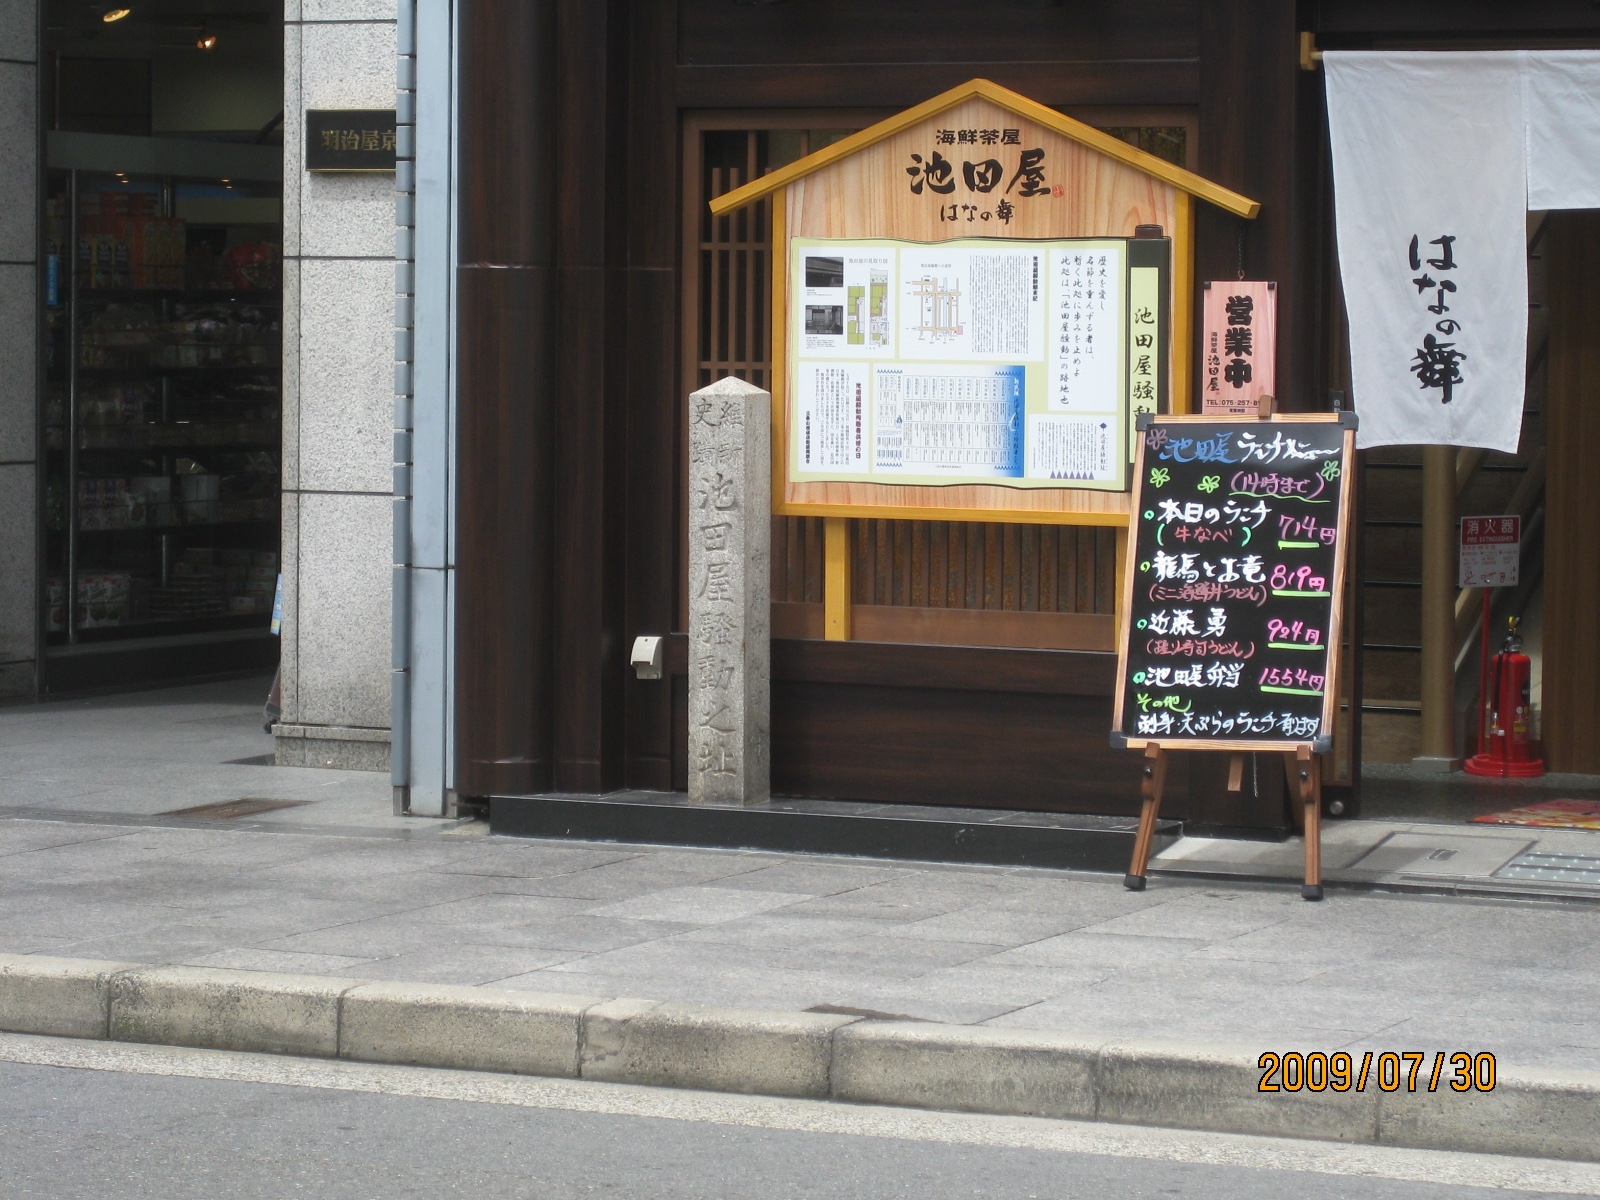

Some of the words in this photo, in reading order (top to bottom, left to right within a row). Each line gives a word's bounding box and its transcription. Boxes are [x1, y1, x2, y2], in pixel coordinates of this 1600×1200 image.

[935, 128, 1022, 146] 海鮮茶屋
[906, 147, 1051, 197] 池田屋
[940, 198, 1016, 226] はなの舞
[1097, 255, 1108, 311] 歴史を愛し
[1408, 233, 1467, 405] はなの舞
[1224, 294, 1254, 389] 営業中
[1206, 355, 1221, 392] 池田屋
[1157, 498, 1273, 530] 本日のランチ
[1279, 514, 1337, 546] 714円
[1466, 518, 1515, 536] 消火器
[1270, 564, 1326, 591] 819円
[1267, 618, 1321, 645] 924円
[1258, 667, 1326, 692] 1554円
[1136, 693, 1192, 712] その他
